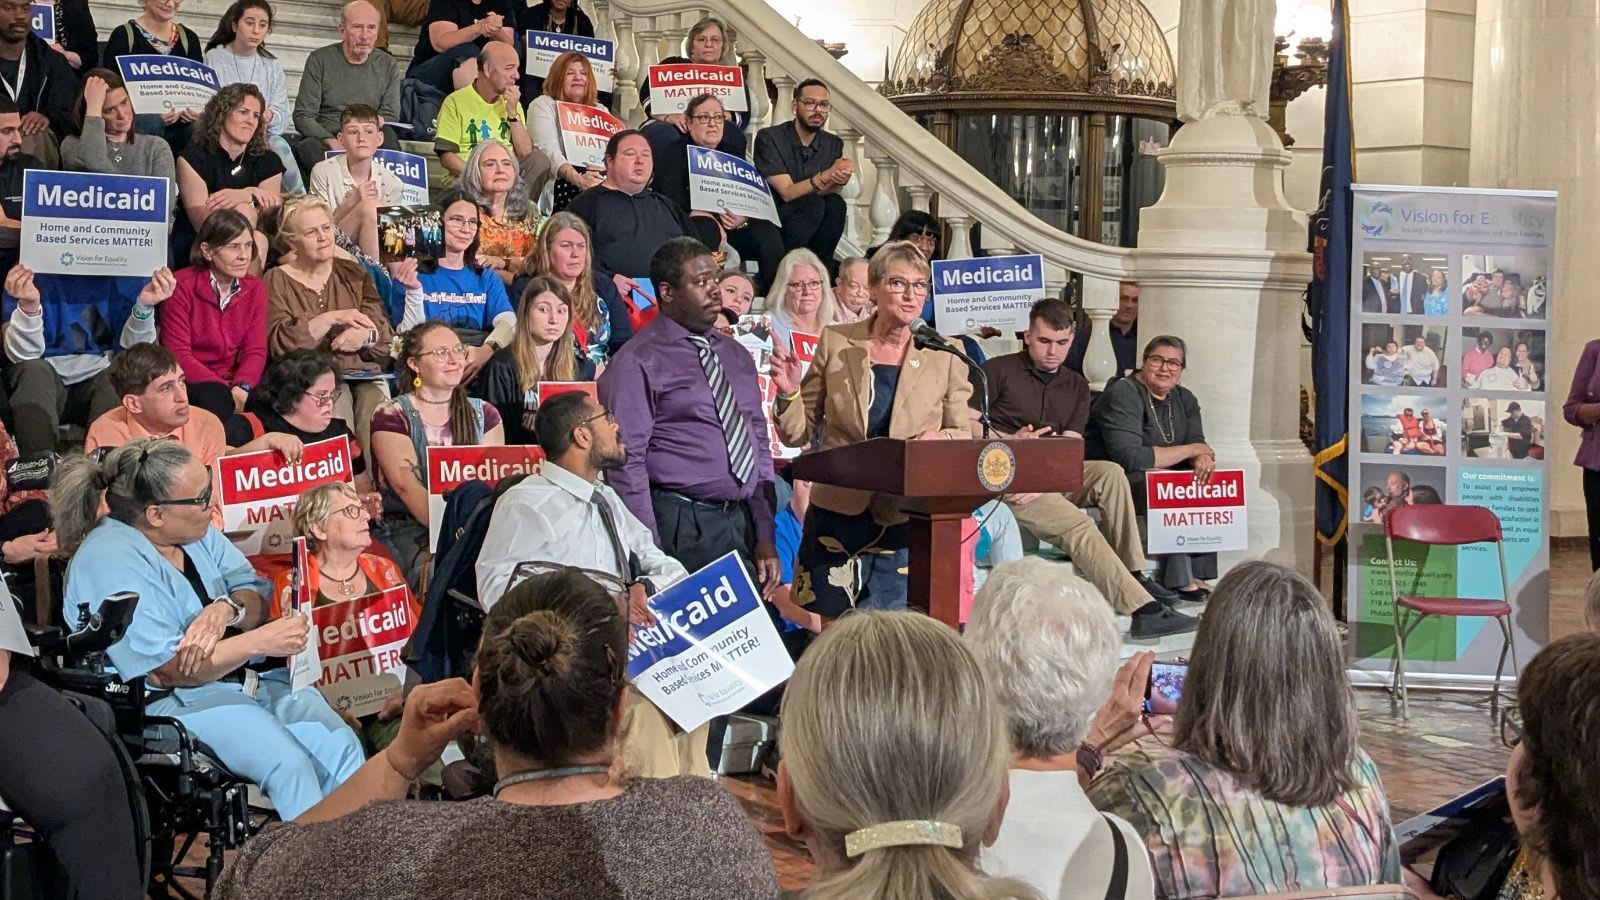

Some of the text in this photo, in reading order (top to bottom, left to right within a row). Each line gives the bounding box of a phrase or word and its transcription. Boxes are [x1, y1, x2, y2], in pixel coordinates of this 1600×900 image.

[535, 36, 607, 56] Medicaid
[129, 62, 215, 85] Medicaid
[657, 69, 734, 82] Medicaid
[664, 87, 731, 98] MATTERS!
[566, 111, 623, 135] Medicai
[697, 154, 765, 188] Medicaid
[38, 183, 155, 211] Medicaid
[700, 186, 719, 194] Based
[1401, 209, 1447, 225] Vision
[1453, 210, 1474, 225] for
[40, 222, 151, 237] Home and Community
[36, 234, 153, 247] Based Services MATTER!
[942, 263, 1033, 286] Medicaid
[947, 294, 1032, 305] Home and Community
[970, 304, 1000, 312] Services
[1002, 302, 1033, 310] MATTER
[234, 450, 344, 492] Medicaid
[1462, 472, 1476, 480] Our
[1478, 473, 1526, 481] commitment
[1156, 475, 1238, 500] Medicaid
[1492, 504, 1516, 512] families
[1163, 510, 1233, 526] MATTERS!
[1523, 526, 1539, 534] equal
[316, 600, 407, 648] edicaid
[652, 664, 680, 683] Home
[661, 677, 688, 696] Based
[353, 692, 373, 702] Vision
